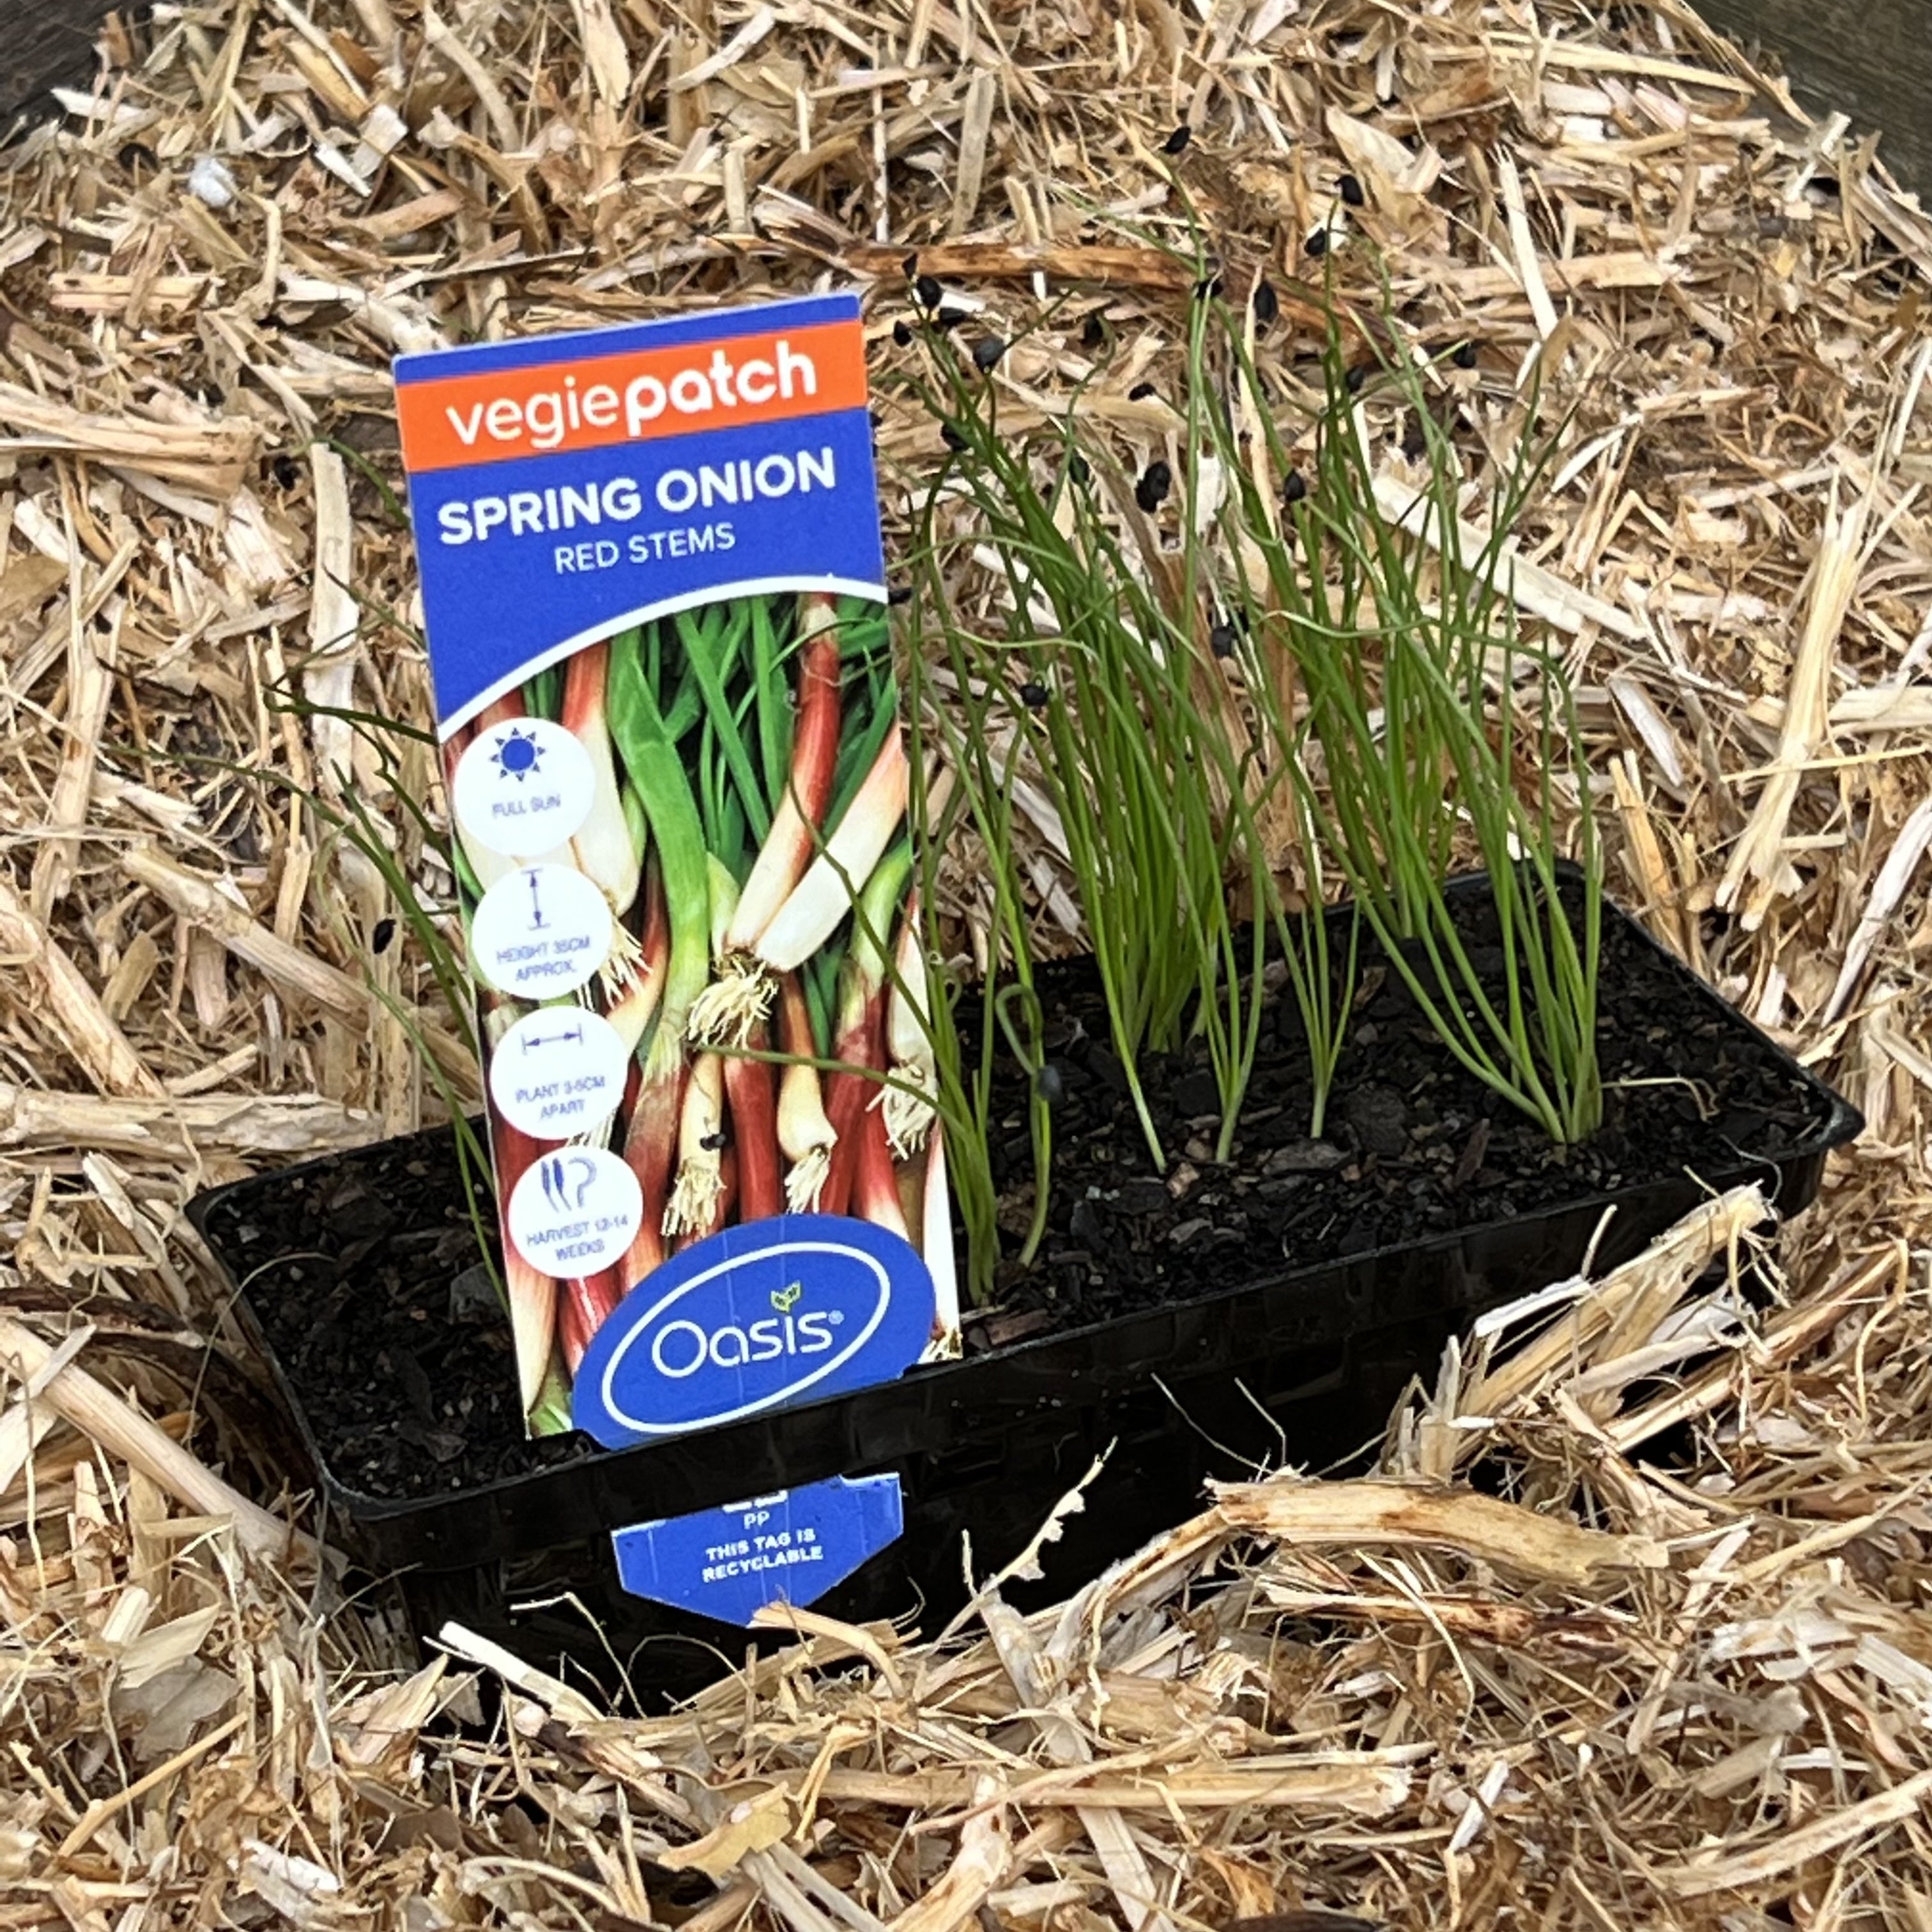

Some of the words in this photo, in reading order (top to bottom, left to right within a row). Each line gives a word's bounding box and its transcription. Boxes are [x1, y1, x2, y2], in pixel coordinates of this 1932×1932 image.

[438, 478, 641, 545] SPRING
[656, 447, 836, 512] ONION
[555, 543, 619, 574] RED
[629, 521, 736, 564] STEMS
[491, 801, 526, 818] FULL
[532, 795, 561, 812] SUN
[496, 942, 549, 963] HEIGHT
[516, 1083, 559, 1105] PLANT
[540, 1100, 585, 1119] APART
[526, 1223, 590, 1248] HARVEST
[594, 1215, 629, 1234] 12-14
[555, 1239, 606, 1261] WEEKS
[705, 1538, 750, 1563] THIS
[754, 1532, 792, 1552] TAG
[796, 1528, 816, 1544] IS
[702, 1545, 824, 1583] RECYCLABLE
